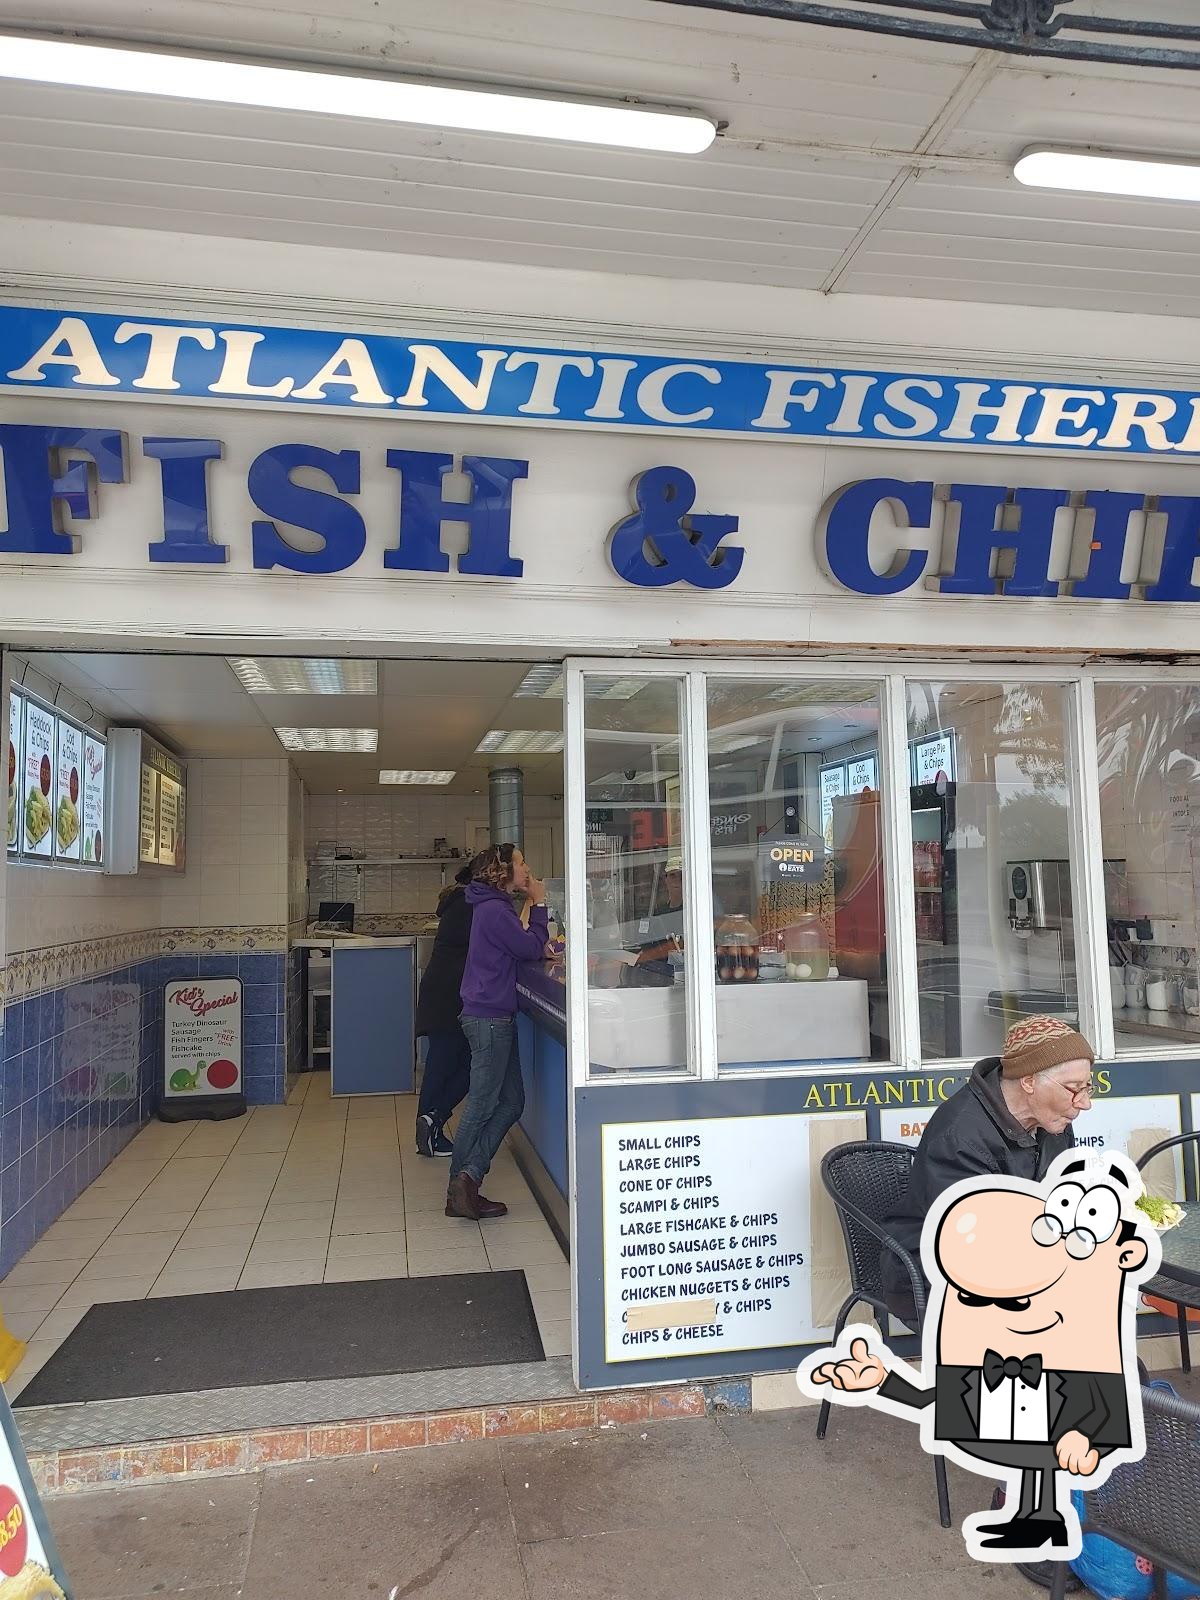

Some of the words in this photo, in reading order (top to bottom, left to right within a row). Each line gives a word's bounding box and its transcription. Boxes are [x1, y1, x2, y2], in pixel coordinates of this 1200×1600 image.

[6, 317, 722, 424] ATLANTIC
[0, 423, 530, 578] FISH
[607, 465, 745, 589] &
[921, 745, 937, 758] Large
[937, 743, 946, 753] Pie
[924, 759, 929, 770] &
[929, 757, 944, 770] Chips
[857, 773, 870, 785] Chips
[770, 847, 814, 862] OPEN
[168, 986, 205, 1006] Kid's
[189, 991, 239, 1017] Special
[171, 1020, 195, 1028] Turkey
[196, 1019, 227, 1027] Dinosaur
[171, 1028, 202, 1036] Sausage
[171, 1036, 186, 1044] Fish
[187, 1035, 214, 1044] Fingers
[171, 1044, 203, 1053] Fishcake
[205, 1050, 221, 1058] chips
[803, 1077, 955, 1109] ATLANTIC
[618, 1137, 662, 1152] SMALL
[664, 1134, 701, 1149] CHIPS
[618, 1157, 661, 1172] LARGE
[664, 1154, 701, 1169] CHIPS
[619, 1179, 653, 1193] CONE
[656, 1178, 673, 1191] OF
[676, 1175, 713, 1189] CHIPS
[619, 1199, 667, 1215] SCAMPI
[670, 1197, 680, 1211] &
[683, 1195, 720, 1210] CHIPS
[620, 1221, 662, 1236] LARGE
[665, 1216, 727, 1233] FISHCAKE
[729, 1214, 740, 1228] &
[742, 1212, 778, 1227] CHIPS
[620, 1242, 666, 1258] JUMBO
[668, 1237, 726, 1254] SAUSAGE
[729, 1236, 739, 1249] &
[741, 1234, 778, 1249] CHIPS
[621, 1264, 656, 1279] FOOT
[658, 1262, 693, 1277] LONG
[695, 1256, 753, 1274] SAUSAGE
[755, 1255, 765, 1268] &
[768, 1252, 804, 1268] CHIPS
[621, 1284, 676, 1301] CHICKEN
[679, 1279, 739, 1297] NUGGETS
[742, 1278, 752, 1291] &
[754, 1275, 791, 1290] CHIPS
[723, 1301, 733, 1314] &
[736, 1298, 772, 1313] CHIPS
[622, 1329, 660, 1346] CHIPS
[662, 1327, 673, 1341] &
[675, 1324, 724, 1341] CHEESE
